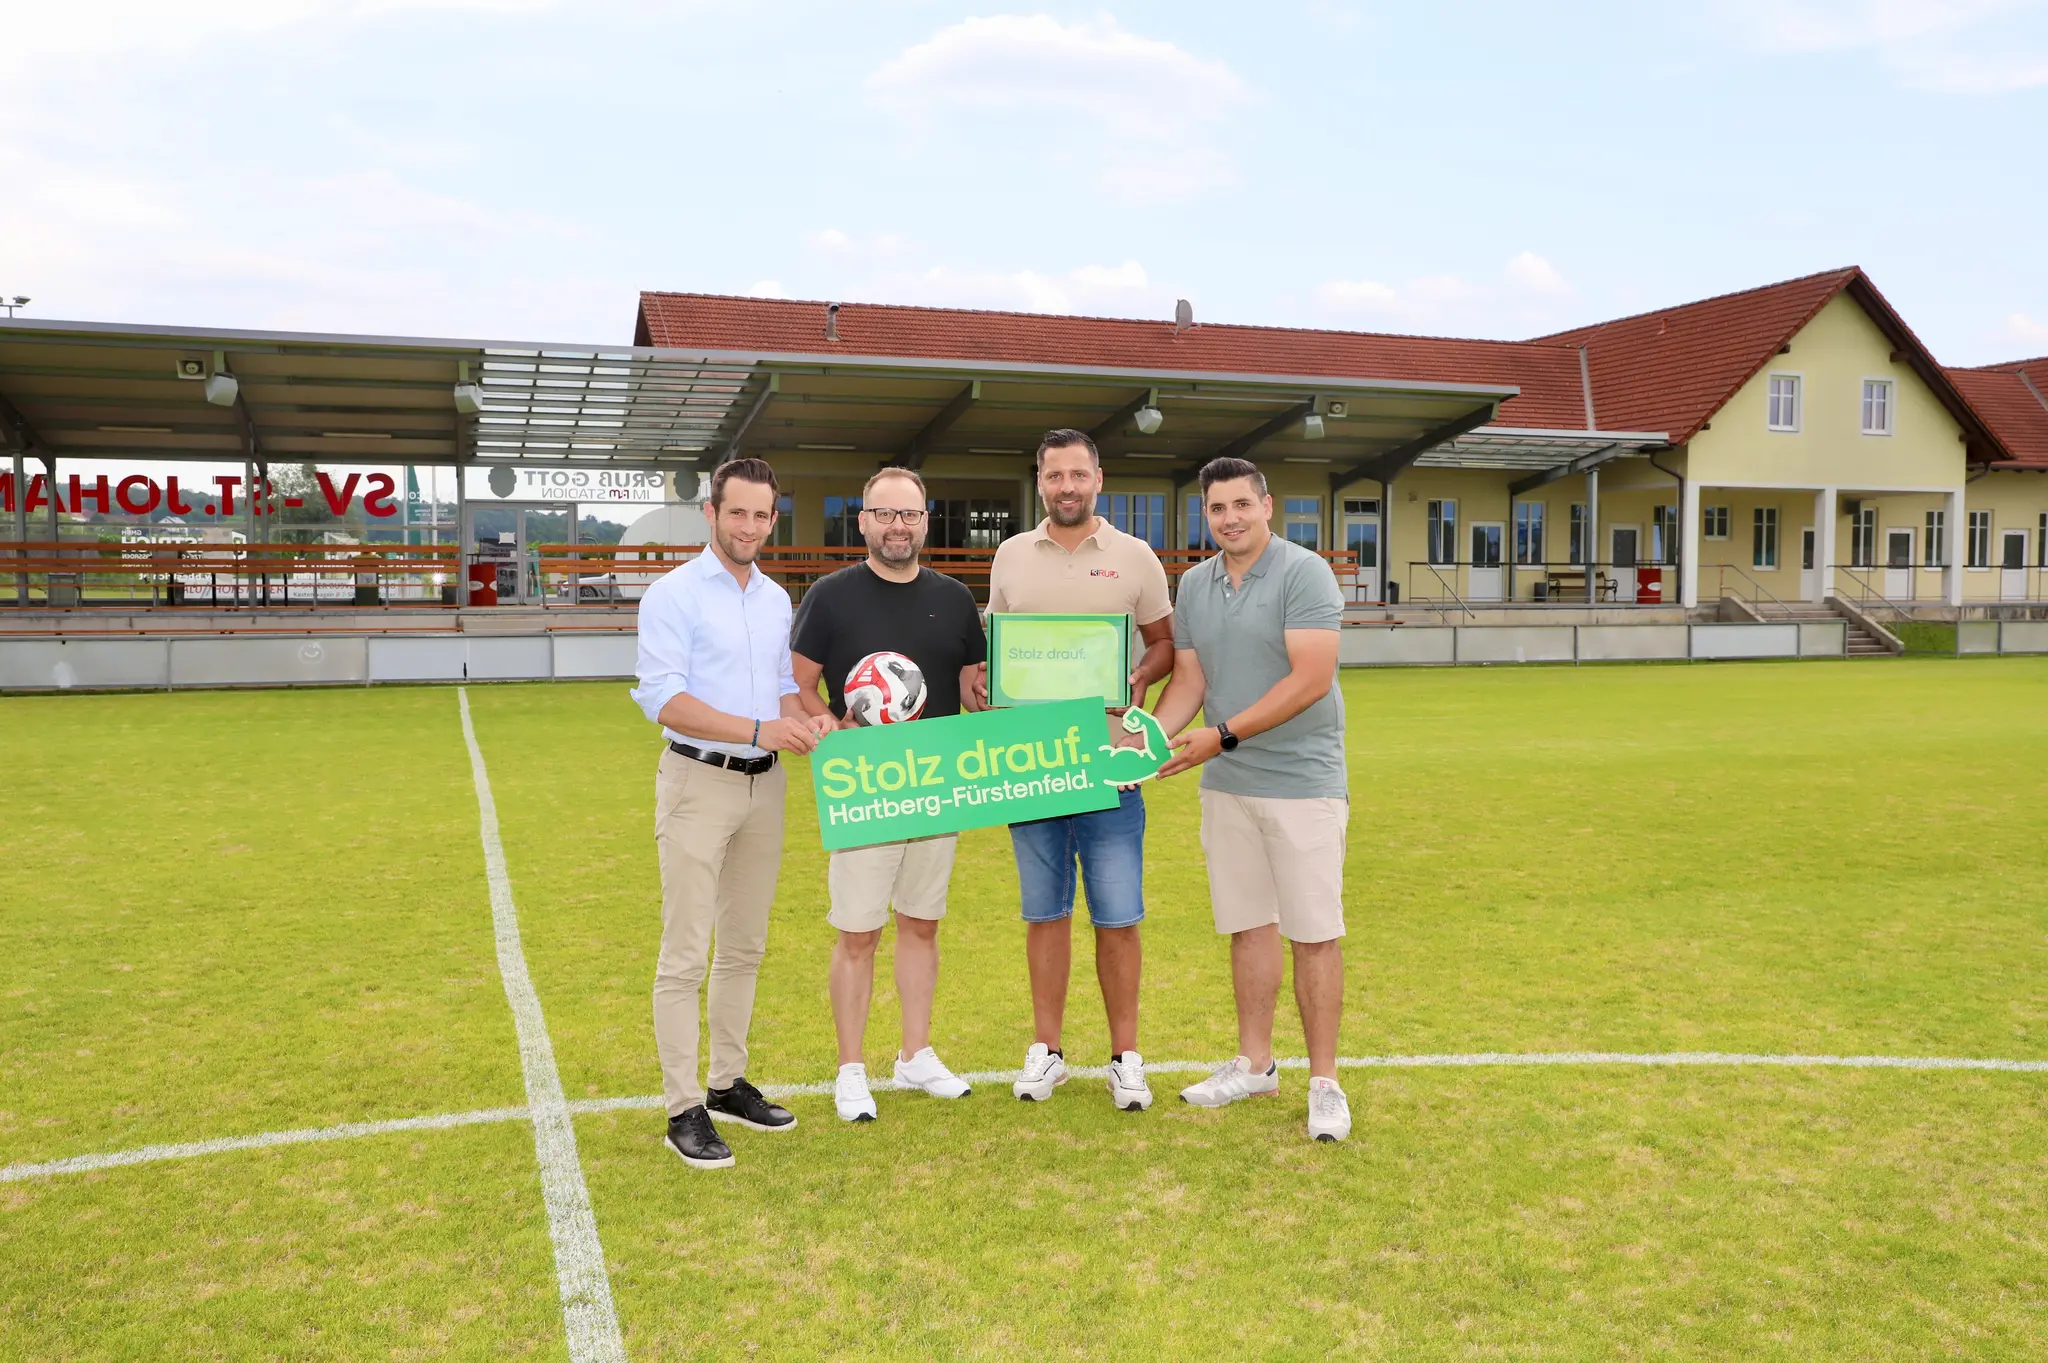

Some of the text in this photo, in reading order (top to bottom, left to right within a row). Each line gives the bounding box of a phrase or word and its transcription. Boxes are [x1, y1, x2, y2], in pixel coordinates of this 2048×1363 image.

[1008, 647, 1086, 660] Stolz drauf.
[821, 725, 1091, 799] Stolz drauf.
[828, 769, 1095, 826] Hartberg-Fürstenfeld.
